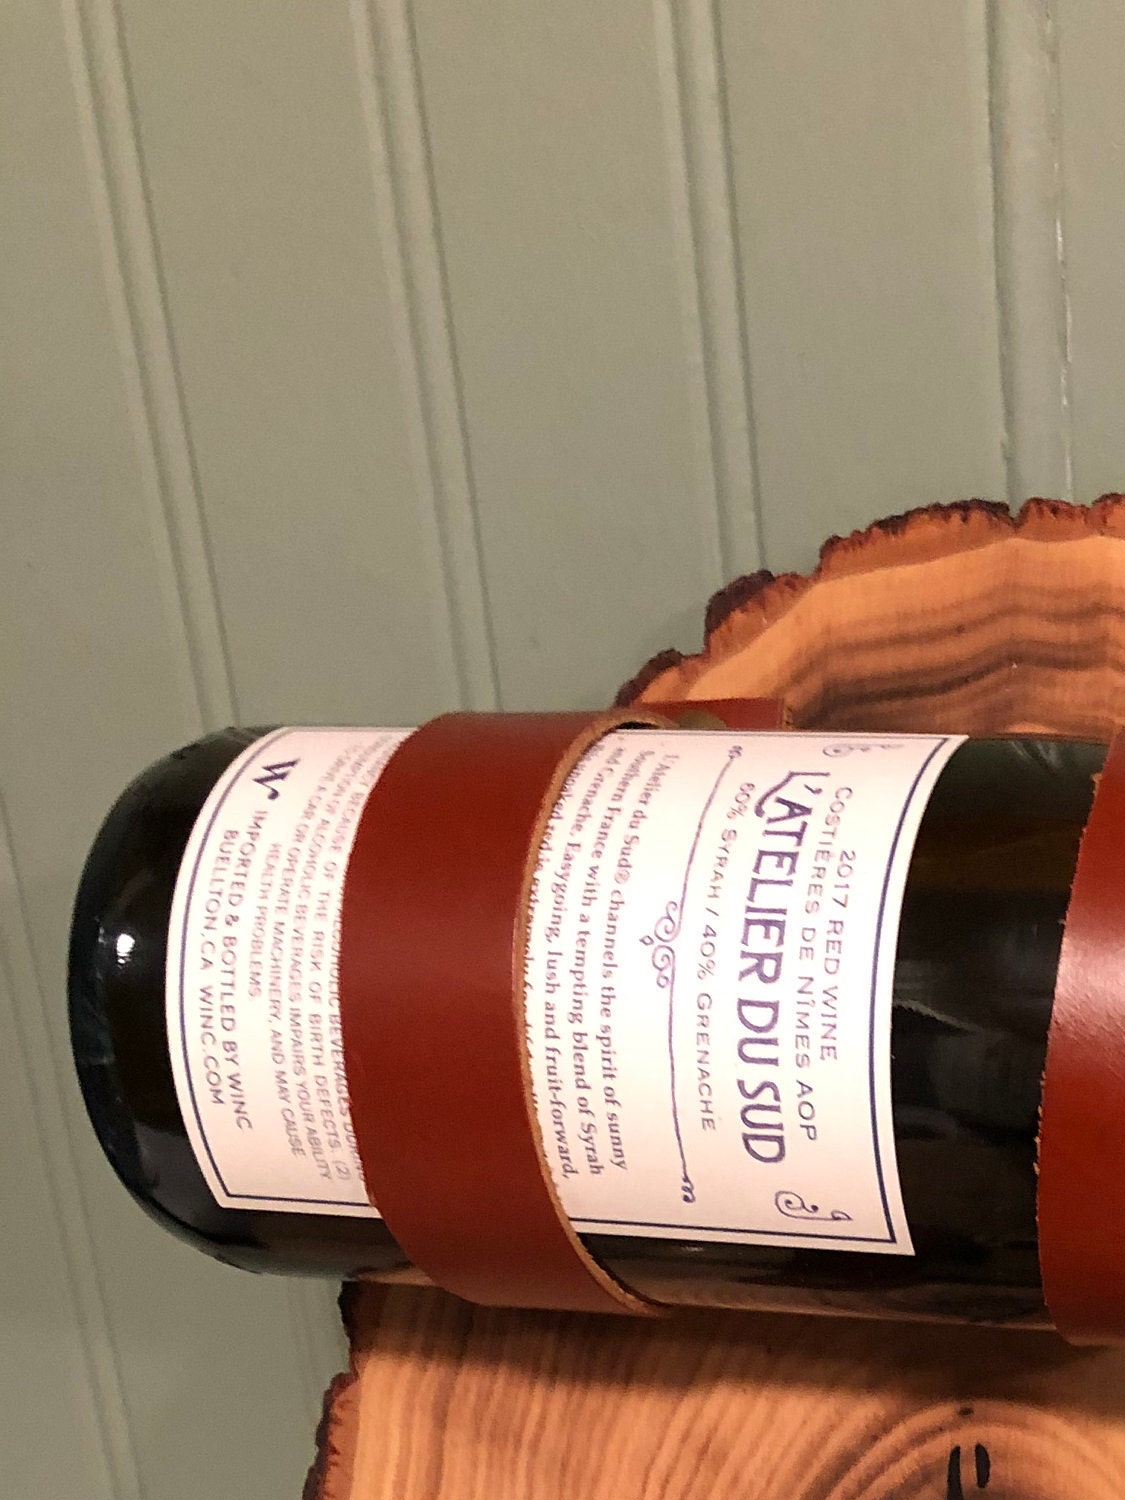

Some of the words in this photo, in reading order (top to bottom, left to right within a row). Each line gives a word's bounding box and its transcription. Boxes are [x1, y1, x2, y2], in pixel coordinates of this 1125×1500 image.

[628, 810, 649, 830] du
[725, 781, 757, 821] 60%
[227, 810, 269, 908] IMPORTED
[591, 806, 622, 860] France
[256, 843, 283, 901] HEALTH
[274, 847, 302, 918] OPERATE
[322, 861, 338, 883] OF
[580, 865, 601, 907] with
[704, 827, 739, 900] SYRAH
[830, 850, 857, 909] 2017
[224, 913, 240, 928] &
[313, 890, 332, 922] THE
[578, 912, 591, 924] a
[601, 888, 625, 979] channels
[287, 903, 310, 1003] BEVERAGES
[309, 930, 326, 973] RISK
[695, 924, 718, 981] 40%
[797, 926, 817, 962] DE
[822, 919, 845, 976] RED
[219, 935, 239, 1032] BOTTLED
[308, 980, 325, 1004] OF
[544, 950, 564, 995] lush
[567, 930, 592, 1025] tempting
[544, 1001, 561, 1040] and
[600, 986, 617, 1018] the
[818, 985, 840, 1061] WINE
[198, 985, 225, 1105] WINC.COM
[221, 1040, 239, 1067] BY
[268, 1029, 286, 1065] AND
[289, 1007, 308, 1077] IMPAIRS
[308, 1012, 326, 1067] BIRTH
[596, 1024, 617, 1081] spirit
[735, 997, 783, 1067] DU
[273, 1069, 293, 1105] MAY
[571, 1031, 592, 1091] blend
[694, 992, 718, 1132] GRENACHE
[226, 1071, 254, 1131] WINC
[295, 1080, 319, 1123] YOUR
[576, 1096, 596, 1117] of
[603, 1086, 622, 1108] of
[736, 1079, 787, 1165] SUD
[796, 1079, 819, 1142] AOP
[279, 1107, 307, 1160] CAUSE
[305, 1125, 333, 1181] ABILITY
[577, 1121, 605, 1176] Syrah
[606, 1112, 628, 1171] sunny
